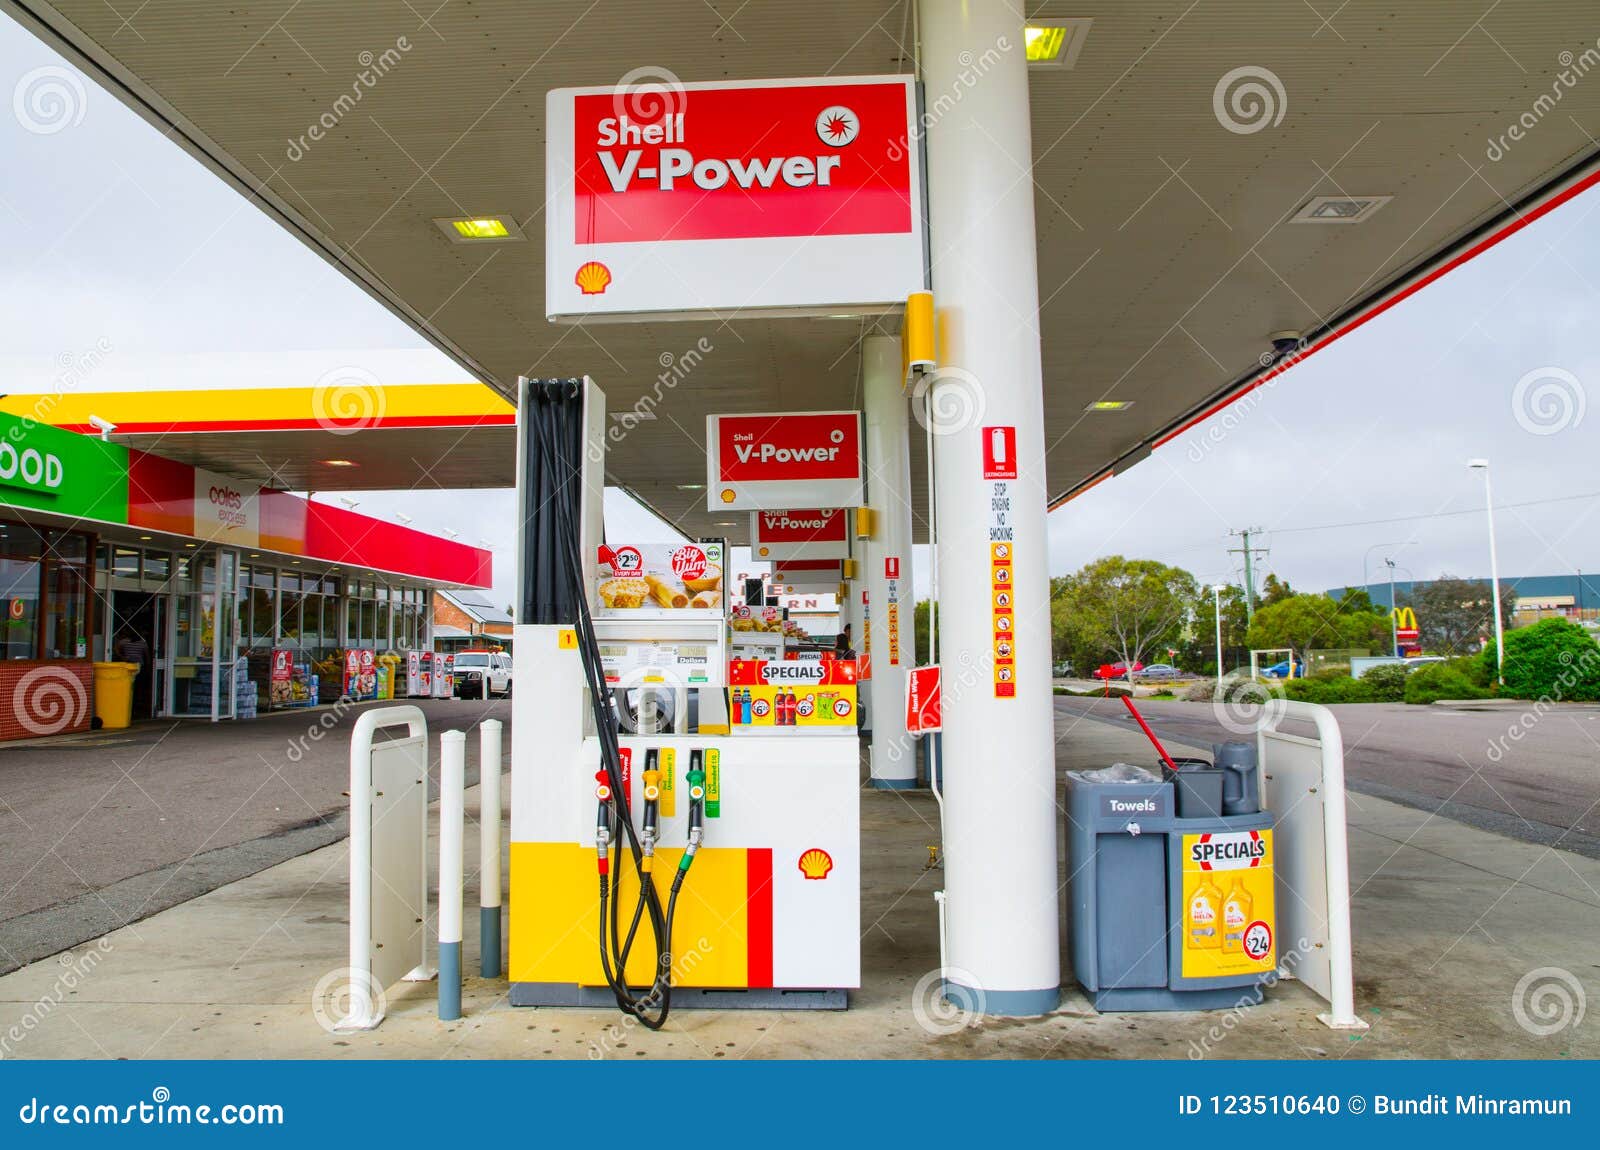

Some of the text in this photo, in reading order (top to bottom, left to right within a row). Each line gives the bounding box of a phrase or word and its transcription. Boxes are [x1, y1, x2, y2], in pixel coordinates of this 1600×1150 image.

[597, 113, 685, 145] Shell
[597, 149, 841, 193] V-Power
[733, 433, 753, 442] Shell
[734, 443, 839, 464] V-Power
[994, 483, 1006, 496] STOP
[209, 486, 241, 510] coles
[992, 498, 1010, 511] ENGINE
[765, 517, 828, 530] V-Power
[997, 512, 1005, 525] NO
[990, 528, 1013, 541] SMOKING
[566, 634, 571, 644] 1
[763, 667, 825, 678] SPECIALS
[911, 693, 919, 712] Hand
[1110, 799, 1156, 812] Towels
[1192, 840, 1265, 862] SPECIALS
[1247, 937, 1268, 953] $24
